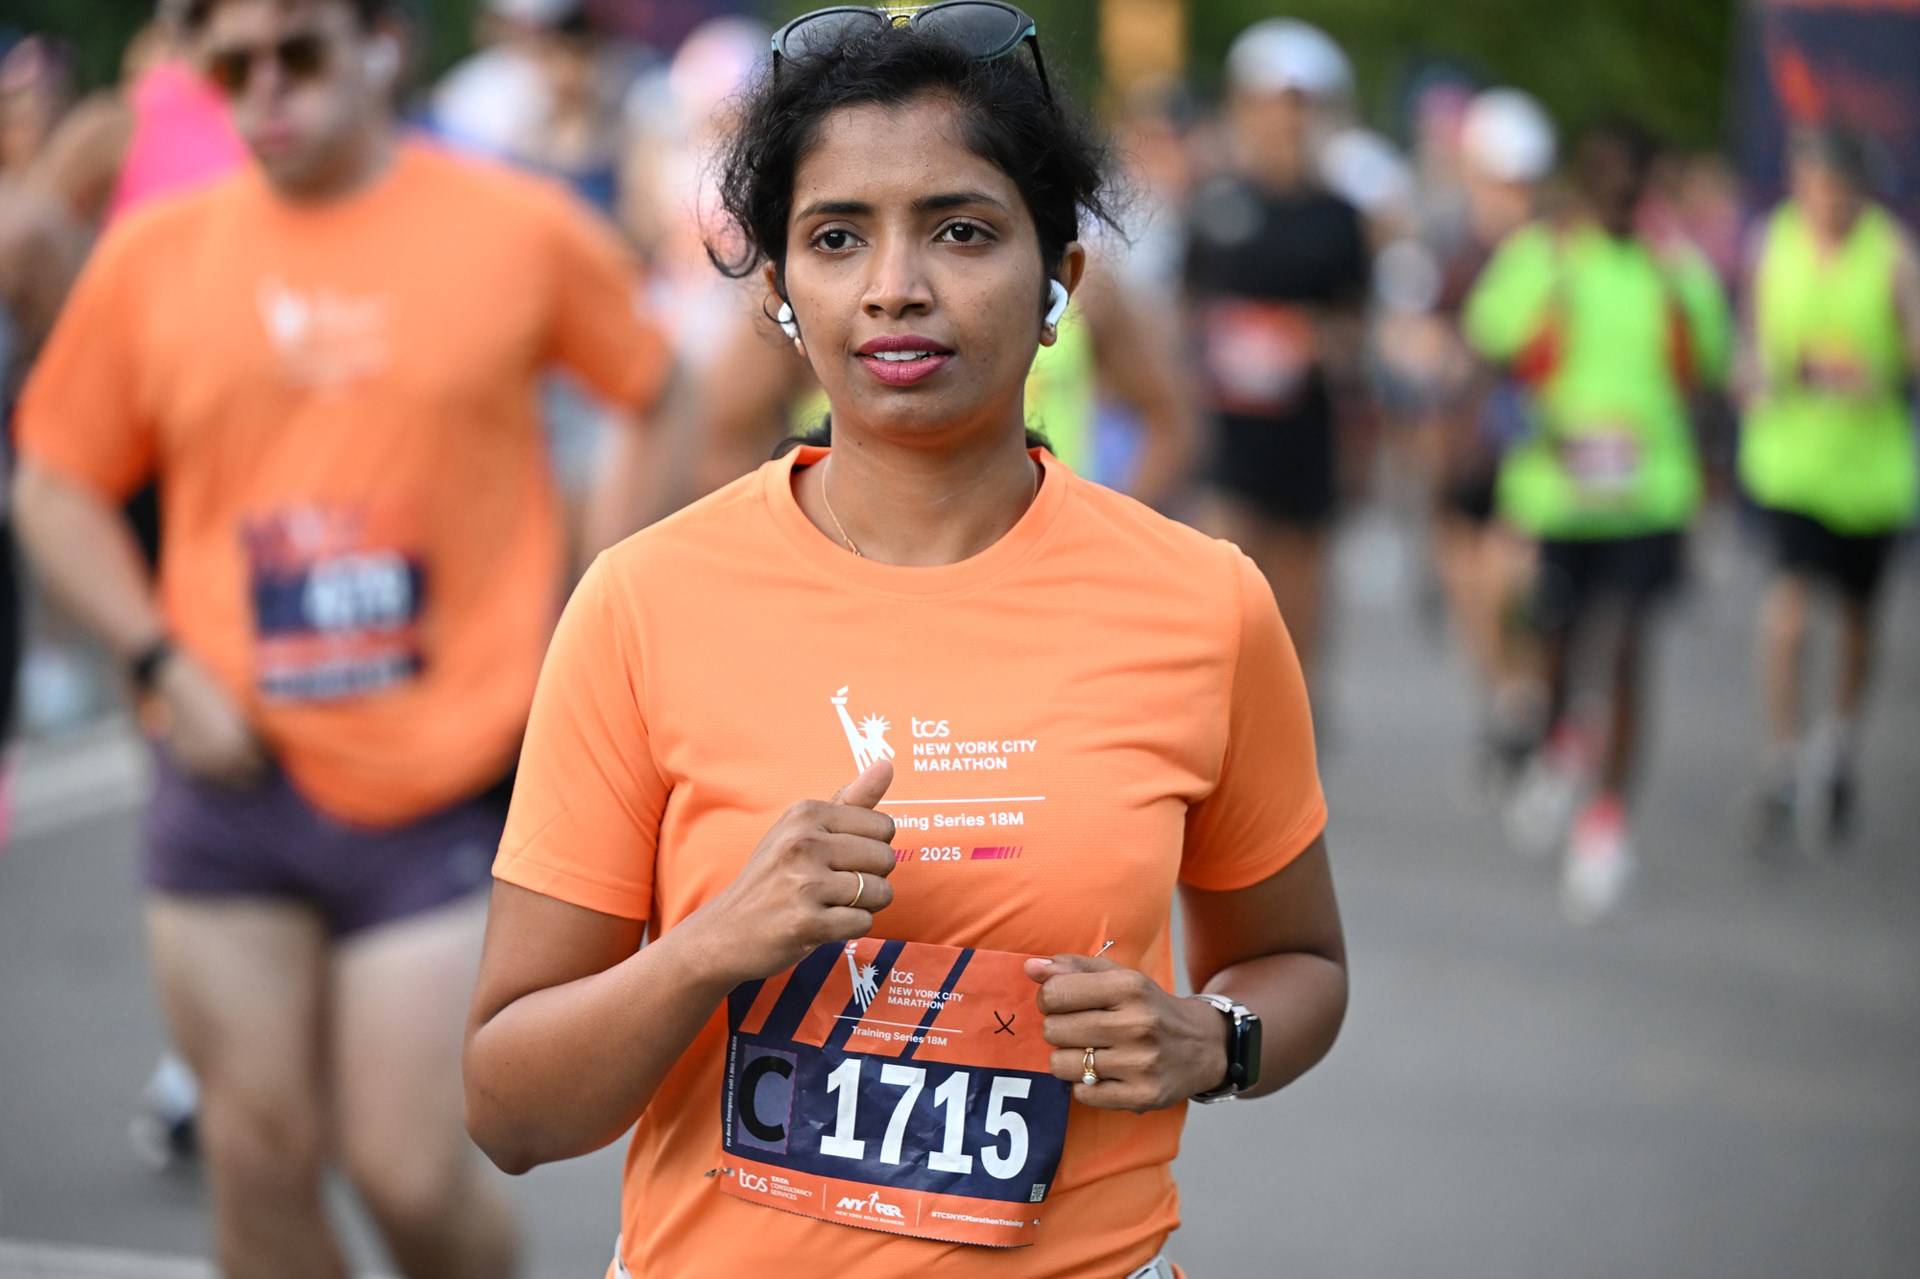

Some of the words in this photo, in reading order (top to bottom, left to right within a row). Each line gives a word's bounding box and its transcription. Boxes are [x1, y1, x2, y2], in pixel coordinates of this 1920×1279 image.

[911, 716, 950, 738] tcs
[912, 742, 951, 756] NEW
[955, 740, 999, 754] YORK
[1001, 739, 1037, 753] CITY
[913, 757, 1008, 772] MARATHON
[889, 814, 929, 831] ning
[933, 813, 986, 828] Series
[989, 811, 1024, 826] 18M
[920, 847, 962, 861] 2025
[890, 967, 914, 984] tcs
[888, 986, 913, 996] NEW
[914, 989, 941, 1000] YORK
[941, 992, 964, 1002] CITY
[887, 996, 945, 1010] MARATHON
[851, 1025, 892, 1041] Training
[893, 1032, 925, 1044] Series
[927, 1036, 948, 1046] 18M
[738, 1055, 794, 1142] C
[820, 1058, 1032, 1179] 1715
[739, 1168, 768, 1193] tcs
[770, 1175, 789, 1185] TATA
[770, 1182, 813, 1197] CONSULTANCY
[770, 1188, 798, 1200] SERVICES
[930, 1211, 1025, 1228] #TCSNYCMarathonTraining
